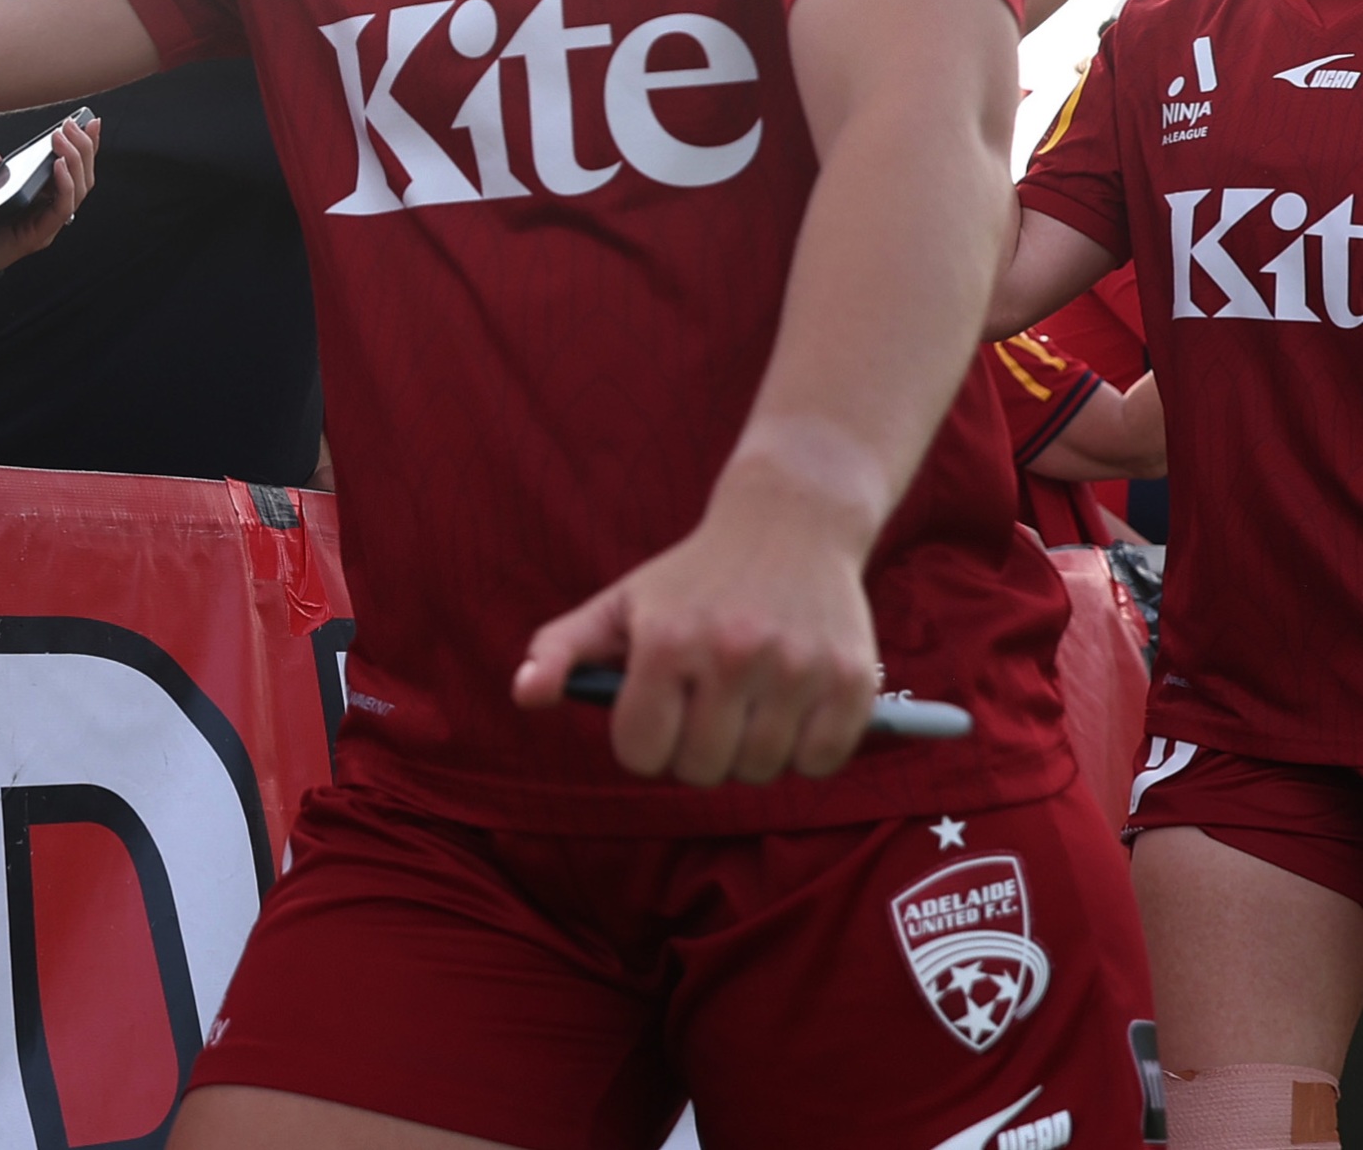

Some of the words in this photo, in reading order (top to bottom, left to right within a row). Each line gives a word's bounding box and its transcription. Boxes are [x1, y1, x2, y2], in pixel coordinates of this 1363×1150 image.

[1161, 99, 1213, 130] NINJA
[1161, 125, 1210, 147] A-LEAGUE
[904, 878, 1018, 922] ADELAIDE
[907, 908, 980, 938] UNITED
[985, 898, 1019, 919] F.C.
